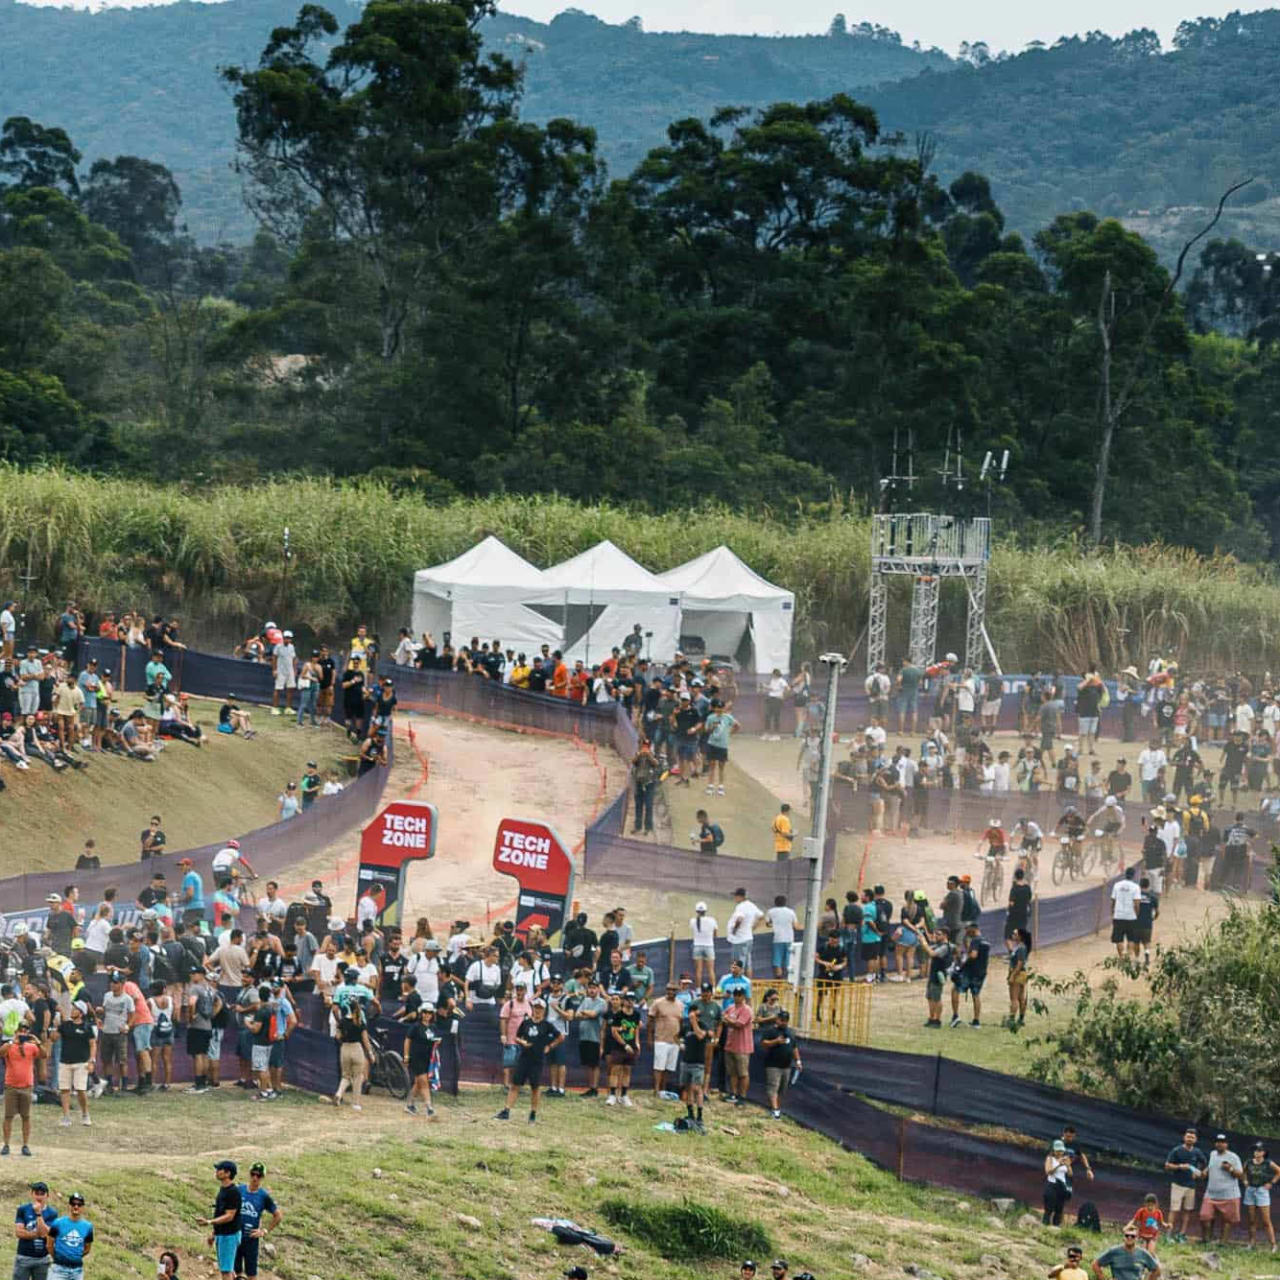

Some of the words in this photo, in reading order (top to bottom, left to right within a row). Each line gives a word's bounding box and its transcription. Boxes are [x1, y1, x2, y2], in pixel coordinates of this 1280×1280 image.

[384, 813, 427, 833] TECH
[382, 829, 427, 849] ZONE
[502, 830, 551, 854] TECH
[498, 846, 549, 871] ZONE
